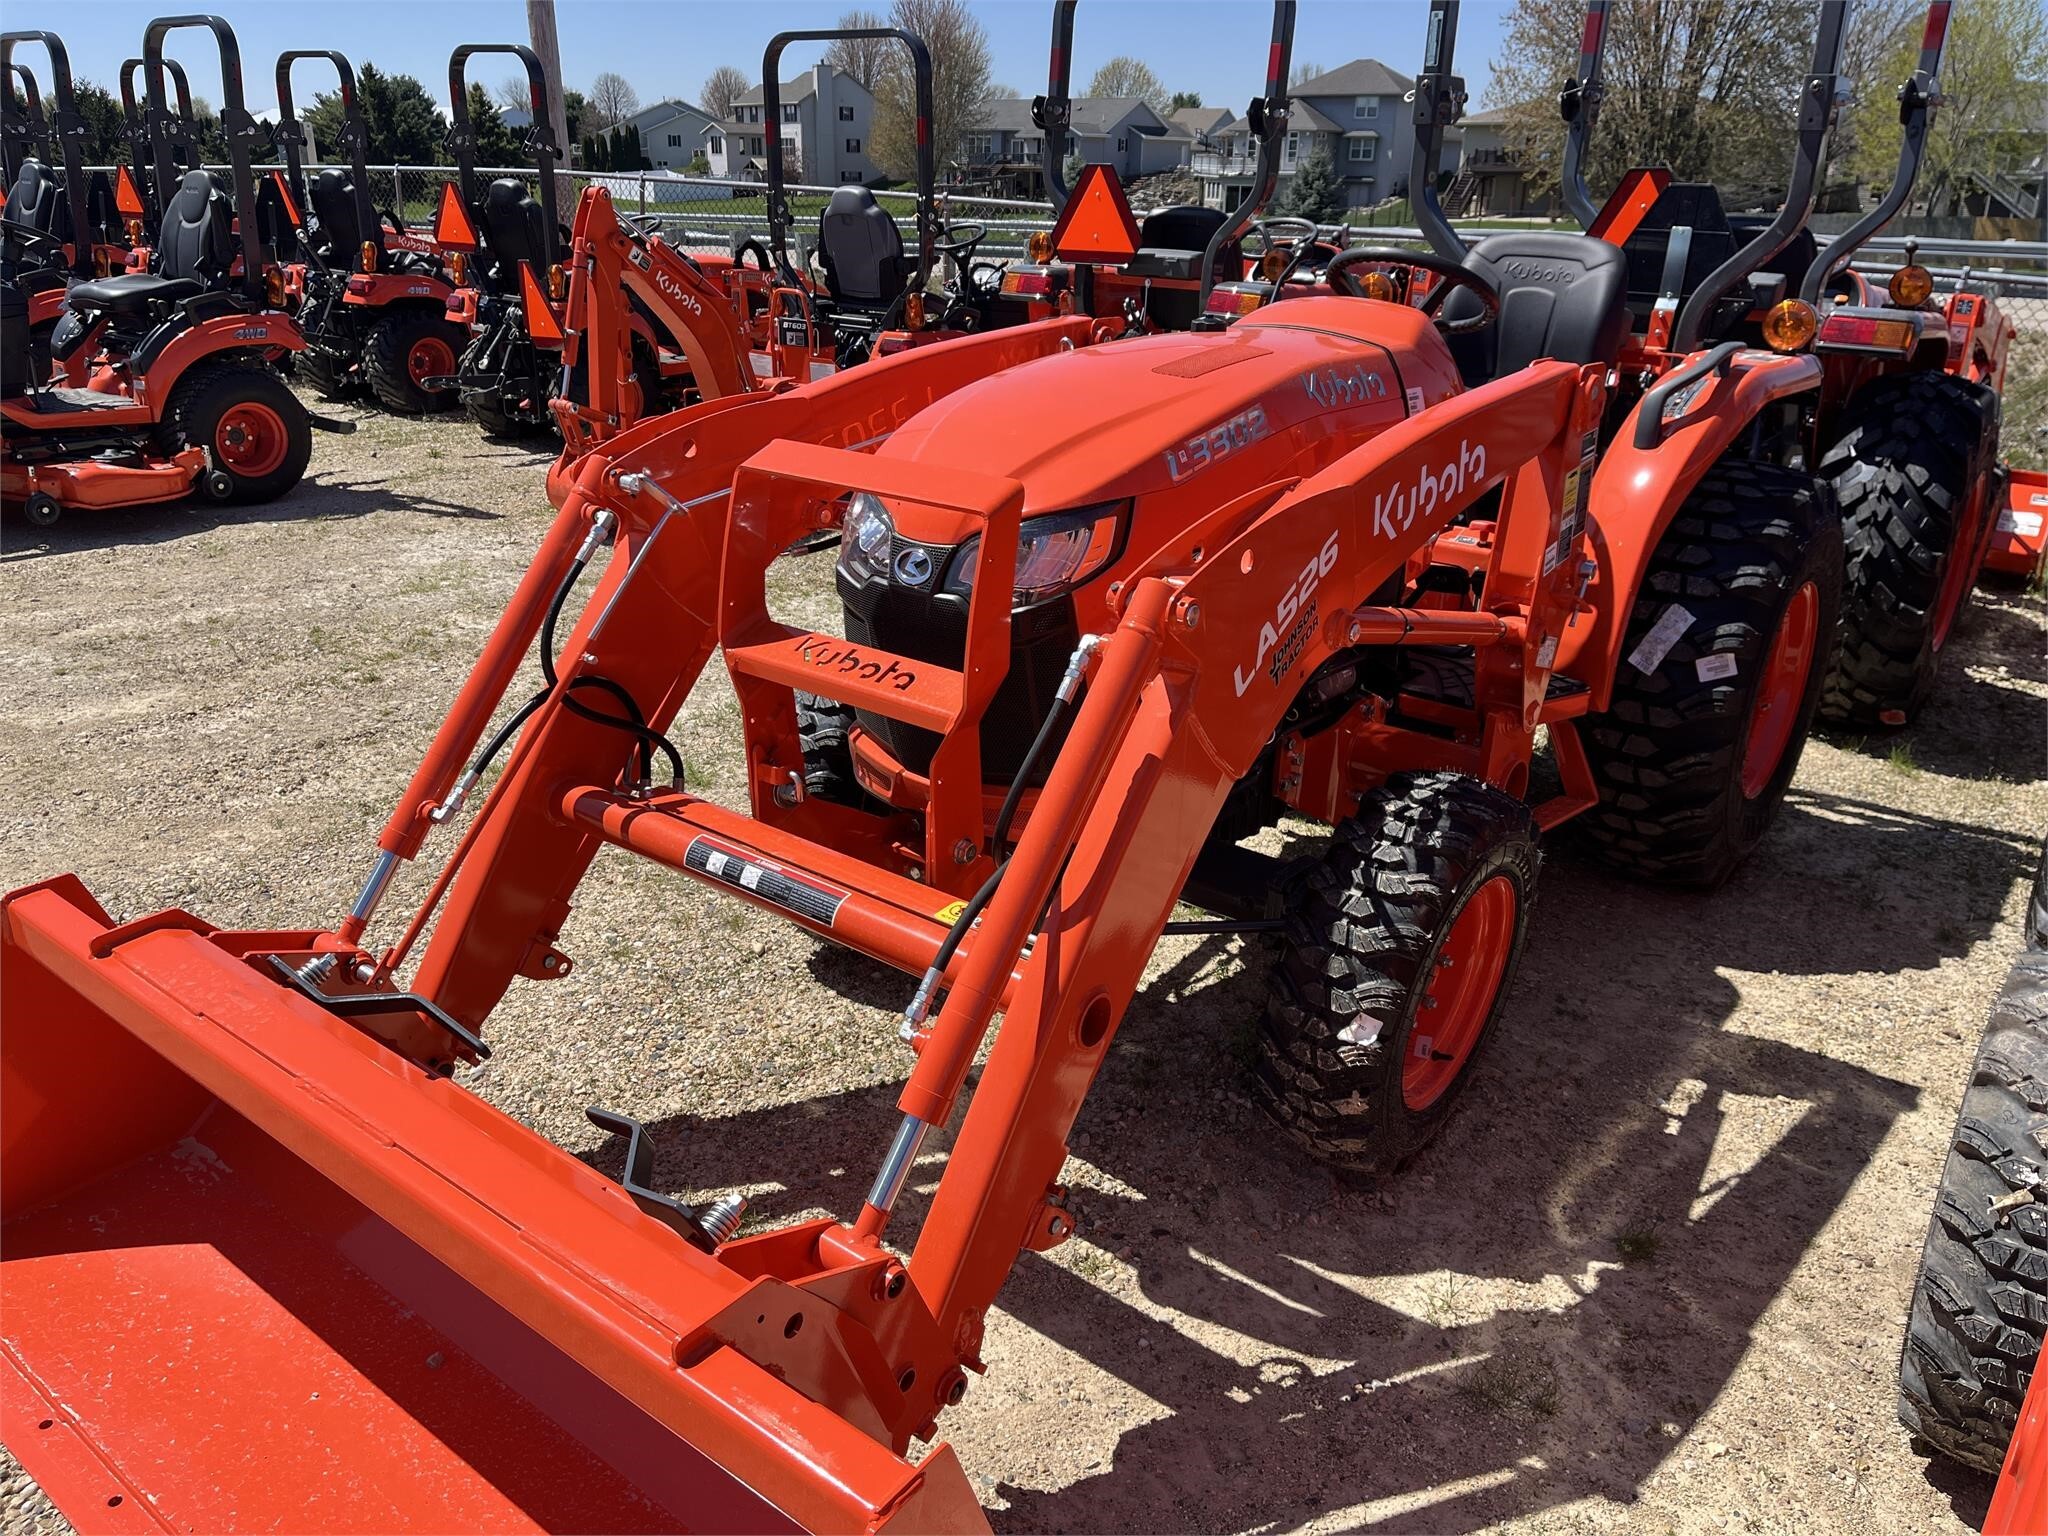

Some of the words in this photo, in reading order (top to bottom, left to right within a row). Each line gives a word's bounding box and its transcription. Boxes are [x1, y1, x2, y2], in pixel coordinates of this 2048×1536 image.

[398, 236, 431, 252] Kubota
[656, 270, 702, 316] Kubota
[1504, 261, 1575, 284] Kubota
[233, 327, 268, 339] 4WD
[783, 321, 806, 330] BT603
[1301, 364, 1386, 408] Kubota
[1165, 404, 1270, 484] L3302
[1373, 439, 1486, 540] Kubota
[1233, 528, 1339, 698] LA526
[1270, 599, 1318, 676] JOHNSON
[794, 636, 917, 691] Kubota
[1272, 615, 1320, 687] TRACTOR
